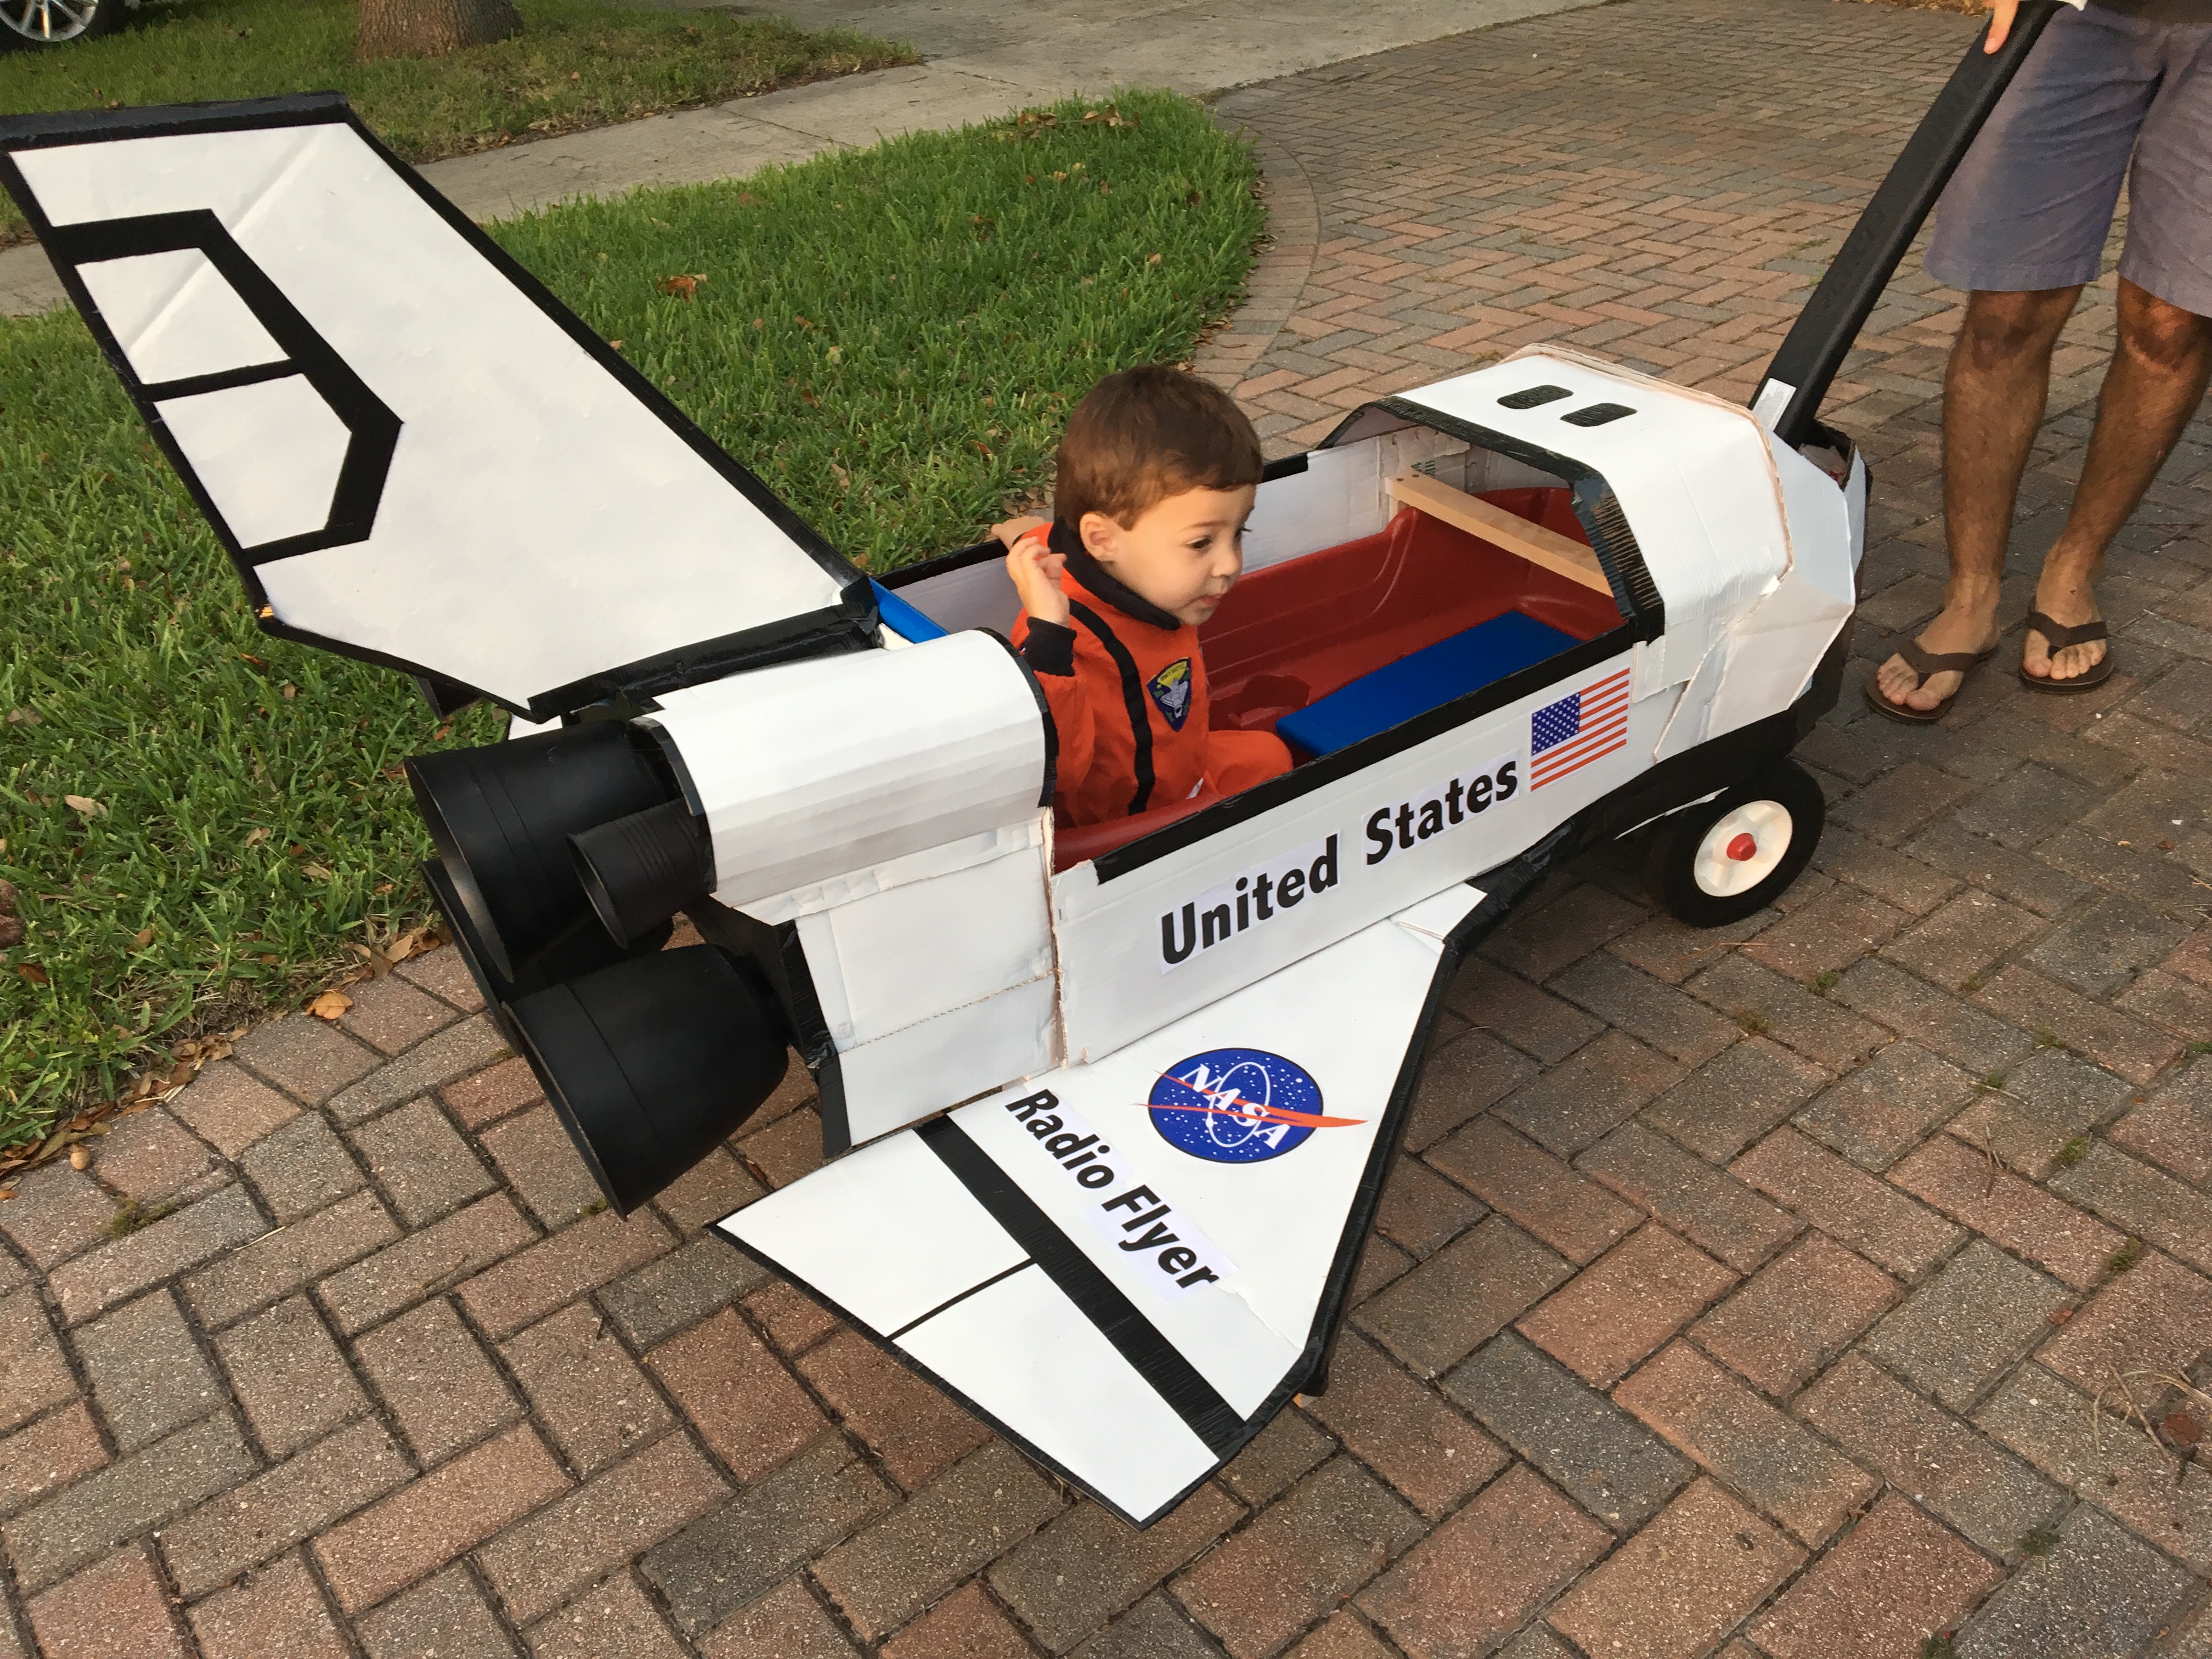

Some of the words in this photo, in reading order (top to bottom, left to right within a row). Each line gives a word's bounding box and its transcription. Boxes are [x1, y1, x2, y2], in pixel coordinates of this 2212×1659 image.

[1161, 833, 1338, 964] United
[1365, 760, 1518, 866] States
[1005, 1088, 1115, 1189] Radio
[1101, 1184, 1220, 1289] Flyer
[1178, 1063, 1291, 1150] NASA
